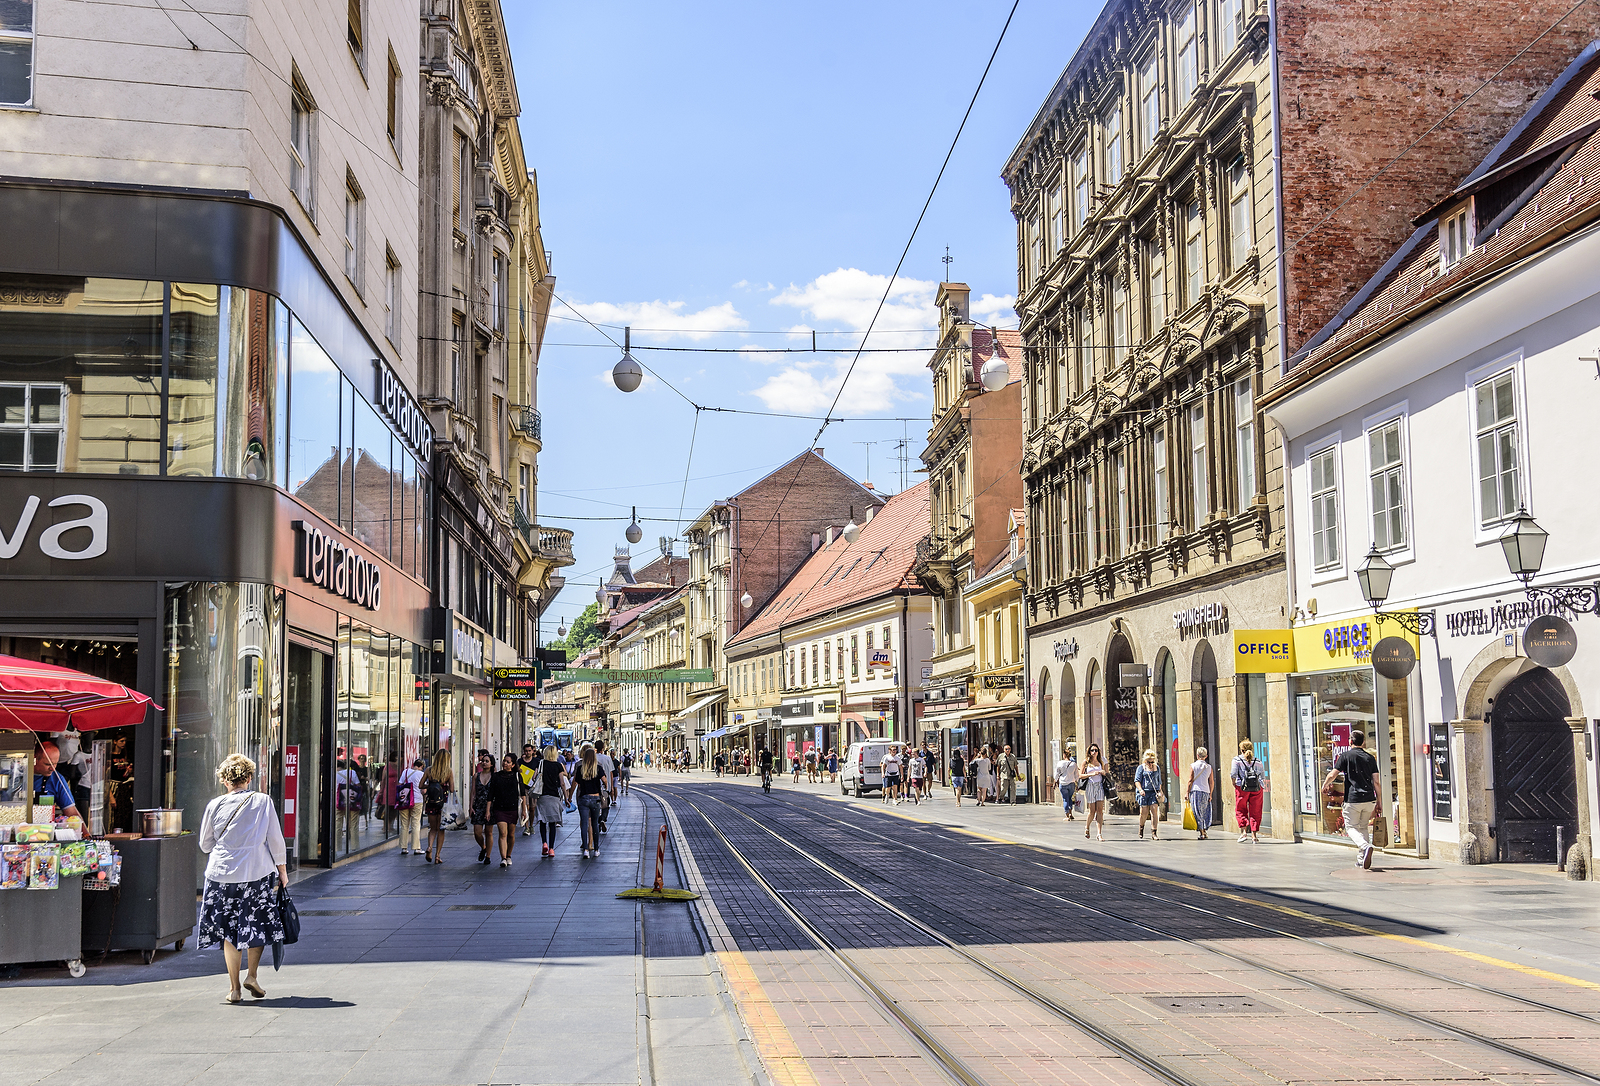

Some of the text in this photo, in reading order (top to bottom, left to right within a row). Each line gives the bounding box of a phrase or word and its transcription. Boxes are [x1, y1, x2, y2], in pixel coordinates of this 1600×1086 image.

[1172, 601, 1224, 630] SPRINGFIELD
[1446, 608, 1487, 630] HOTEL
[1323, 622, 1368, 651] OFFICE
[1506, 635, 1513, 646] 14
[1238, 643, 1289, 655] OFFICE
[1530, 639, 1572, 648] JÄGERHORN
[872, 651, 889, 662] dm
[1353, 650, 1370, 659] SHOES
[607, 671, 663, 681] GLEMBAJEVI
[987, 676, 1013, 684] VINCEK
